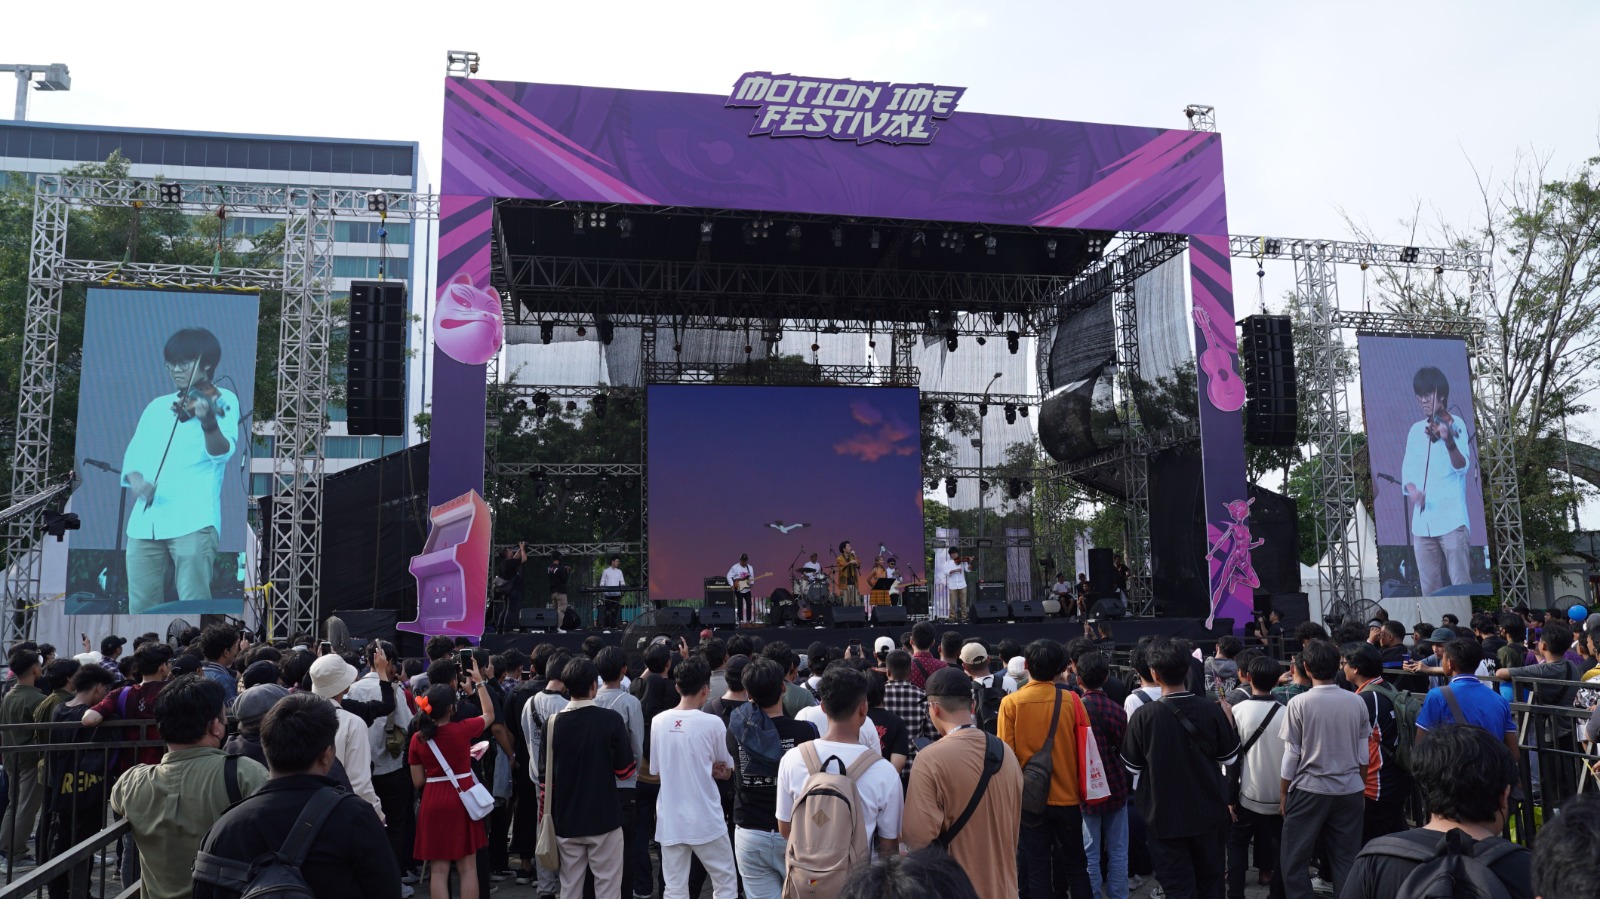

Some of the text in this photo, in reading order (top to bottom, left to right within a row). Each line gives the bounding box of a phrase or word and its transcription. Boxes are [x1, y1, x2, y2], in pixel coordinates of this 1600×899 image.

[735, 76, 956, 114] MOTION IME
[760, 105, 932, 139] FESTIVAL
